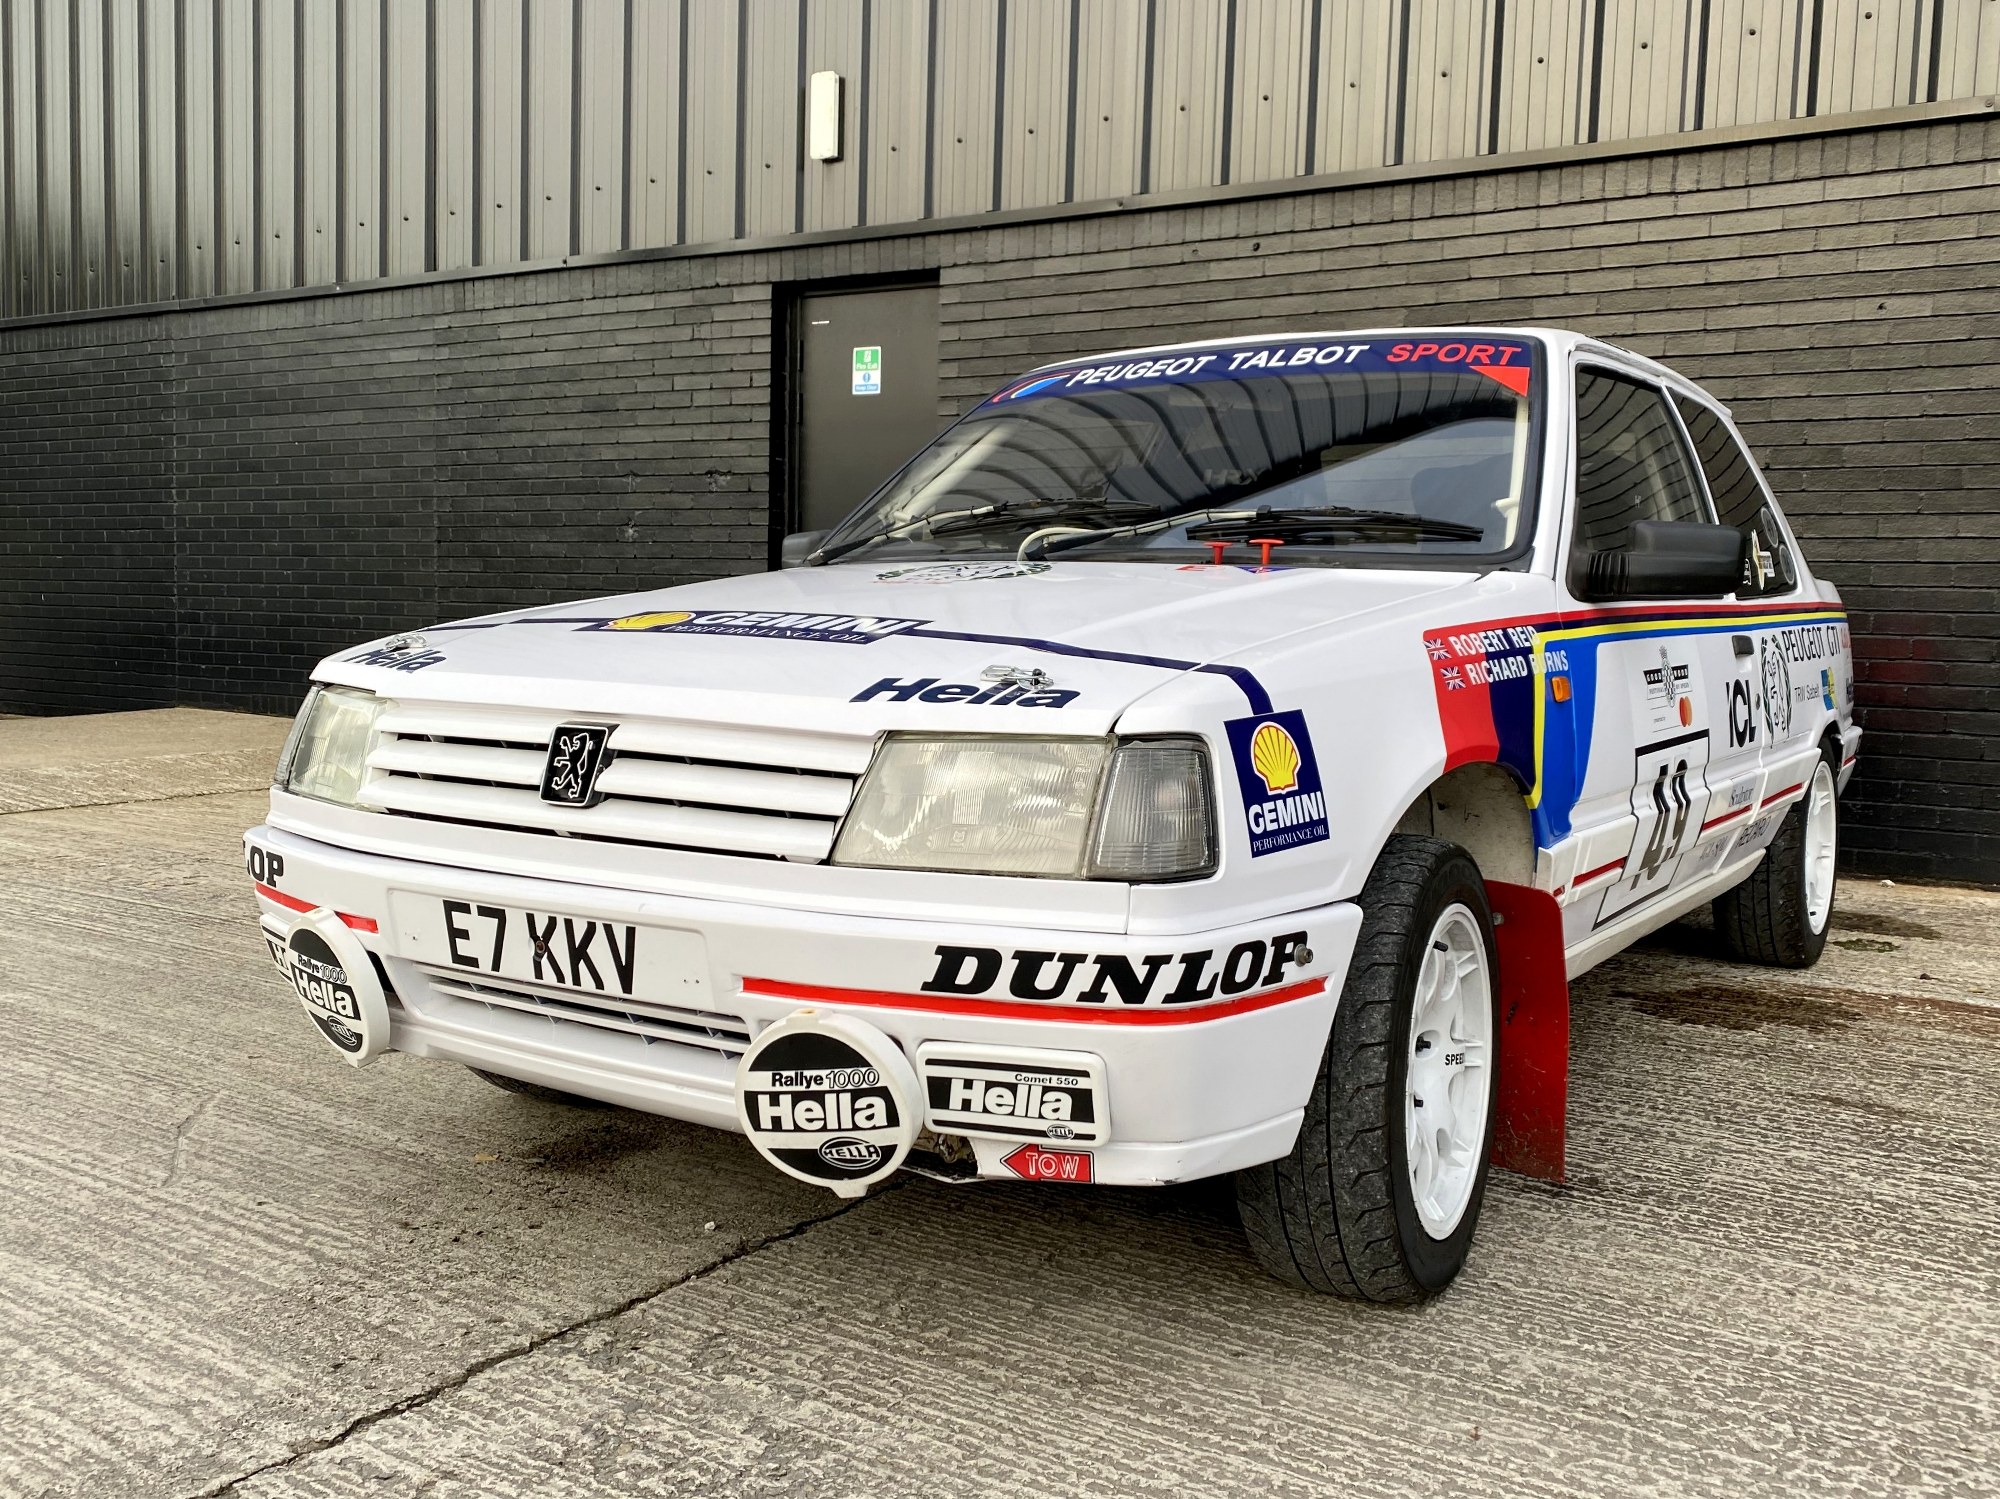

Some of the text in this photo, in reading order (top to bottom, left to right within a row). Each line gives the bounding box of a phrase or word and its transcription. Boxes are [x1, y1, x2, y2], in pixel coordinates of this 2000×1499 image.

[1065, 344, 1522, 387] PEUGEOT TALBOT SPORT
[663, 625, 867, 641] PERFORMANCE OIL
[693, 612, 919, 634] GEMINI
[1448, 626, 1541, 657] ROBERT REID
[1781, 626, 1826, 664] PEUGEOT
[342, 648, 447, 671] Hella
[1465, 649, 1569, 686] RICHARD BURNS
[849, 677, 1081, 709] Hella
[1725, 678, 1757, 748] ICL
[1248, 790, 1326, 835] GEMINI
[1630, 758, 1691, 891] 49
[1252, 824, 1328, 852] PERFORMANCE OIL
[442, 899, 507, 973] E7
[297, 953, 320, 974] Rallye
[319, 964, 347, 984] 1000
[920, 932, 1308, 1004] DUNLOP
[295, 968, 355, 1018] Hella
[329, 1022, 357, 1042] HELLA
[771, 1067, 880, 1089] Rallye 1000
[1015, 1073, 1079, 1086] Comet 550
[757, 1092, 888, 1131] Hella
[949, 1078, 1073, 1121] Hella
[1048, 1127, 1074, 1136] HELLA
[822, 1143, 880, 1159] HELLA
[1026, 1152, 1080, 1180] TOW
